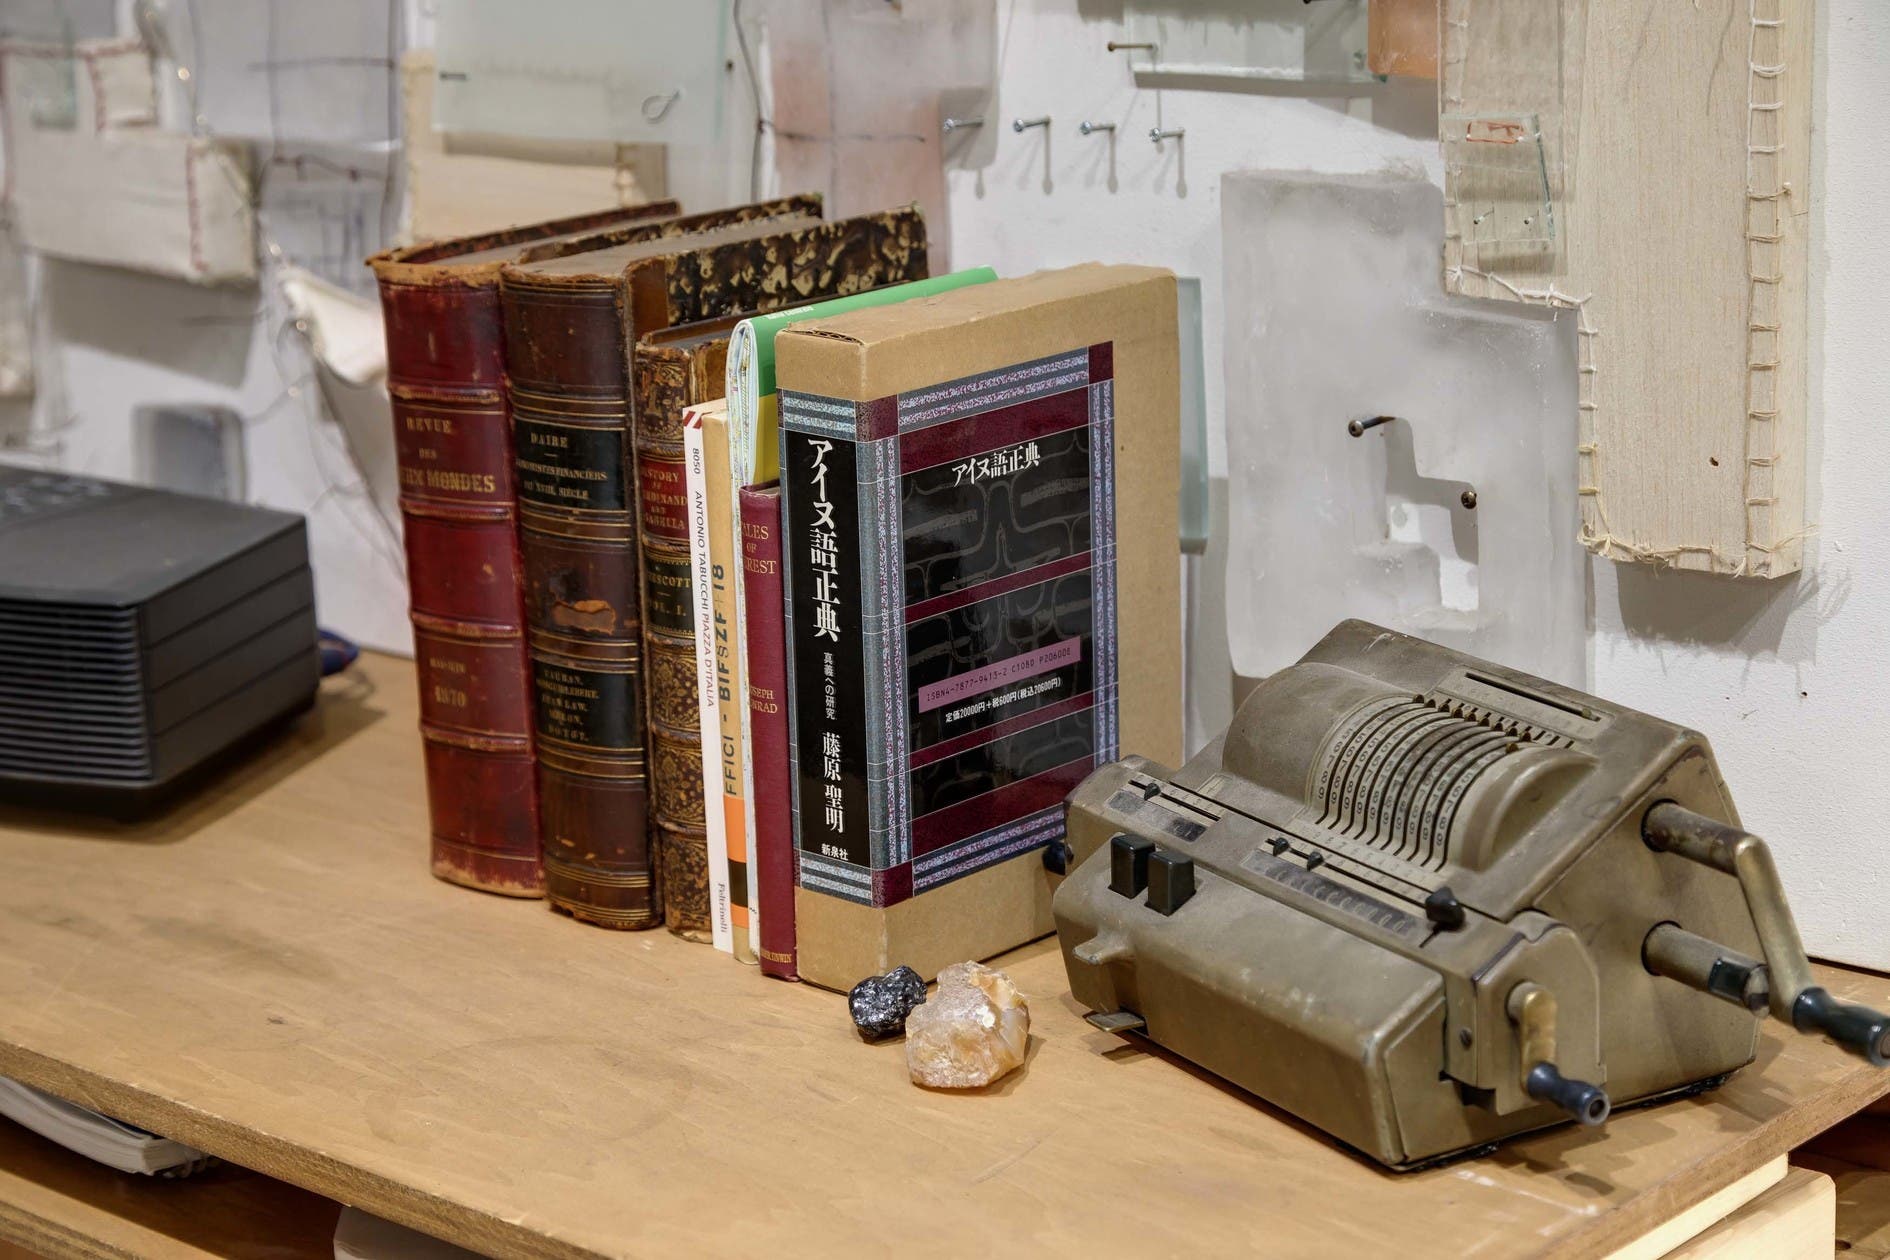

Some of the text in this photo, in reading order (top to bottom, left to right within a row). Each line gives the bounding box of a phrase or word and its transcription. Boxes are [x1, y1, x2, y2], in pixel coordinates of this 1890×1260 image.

[406, 416, 452, 433] REVUE
[418, 447, 438, 460] DES
[530, 432, 569, 449] DAIRE
[692, 447, 701, 475] 8050
[951, 442, 1040, 488] アイヌ語正典
[426, 468, 497, 494] MONDES
[695, 490, 706, 549] ANTONIO
[741, 521, 769, 540] ALES
[746, 542, 757, 553] OF
[807, 438, 841, 643] アイヌ語正典
[698, 551, 709, 610] TABUCCHI
[701, 613, 712, 656] PIAZZA
[722, 735, 737, 796] FFICI
[821, 843, 849, 861] 新泉社
